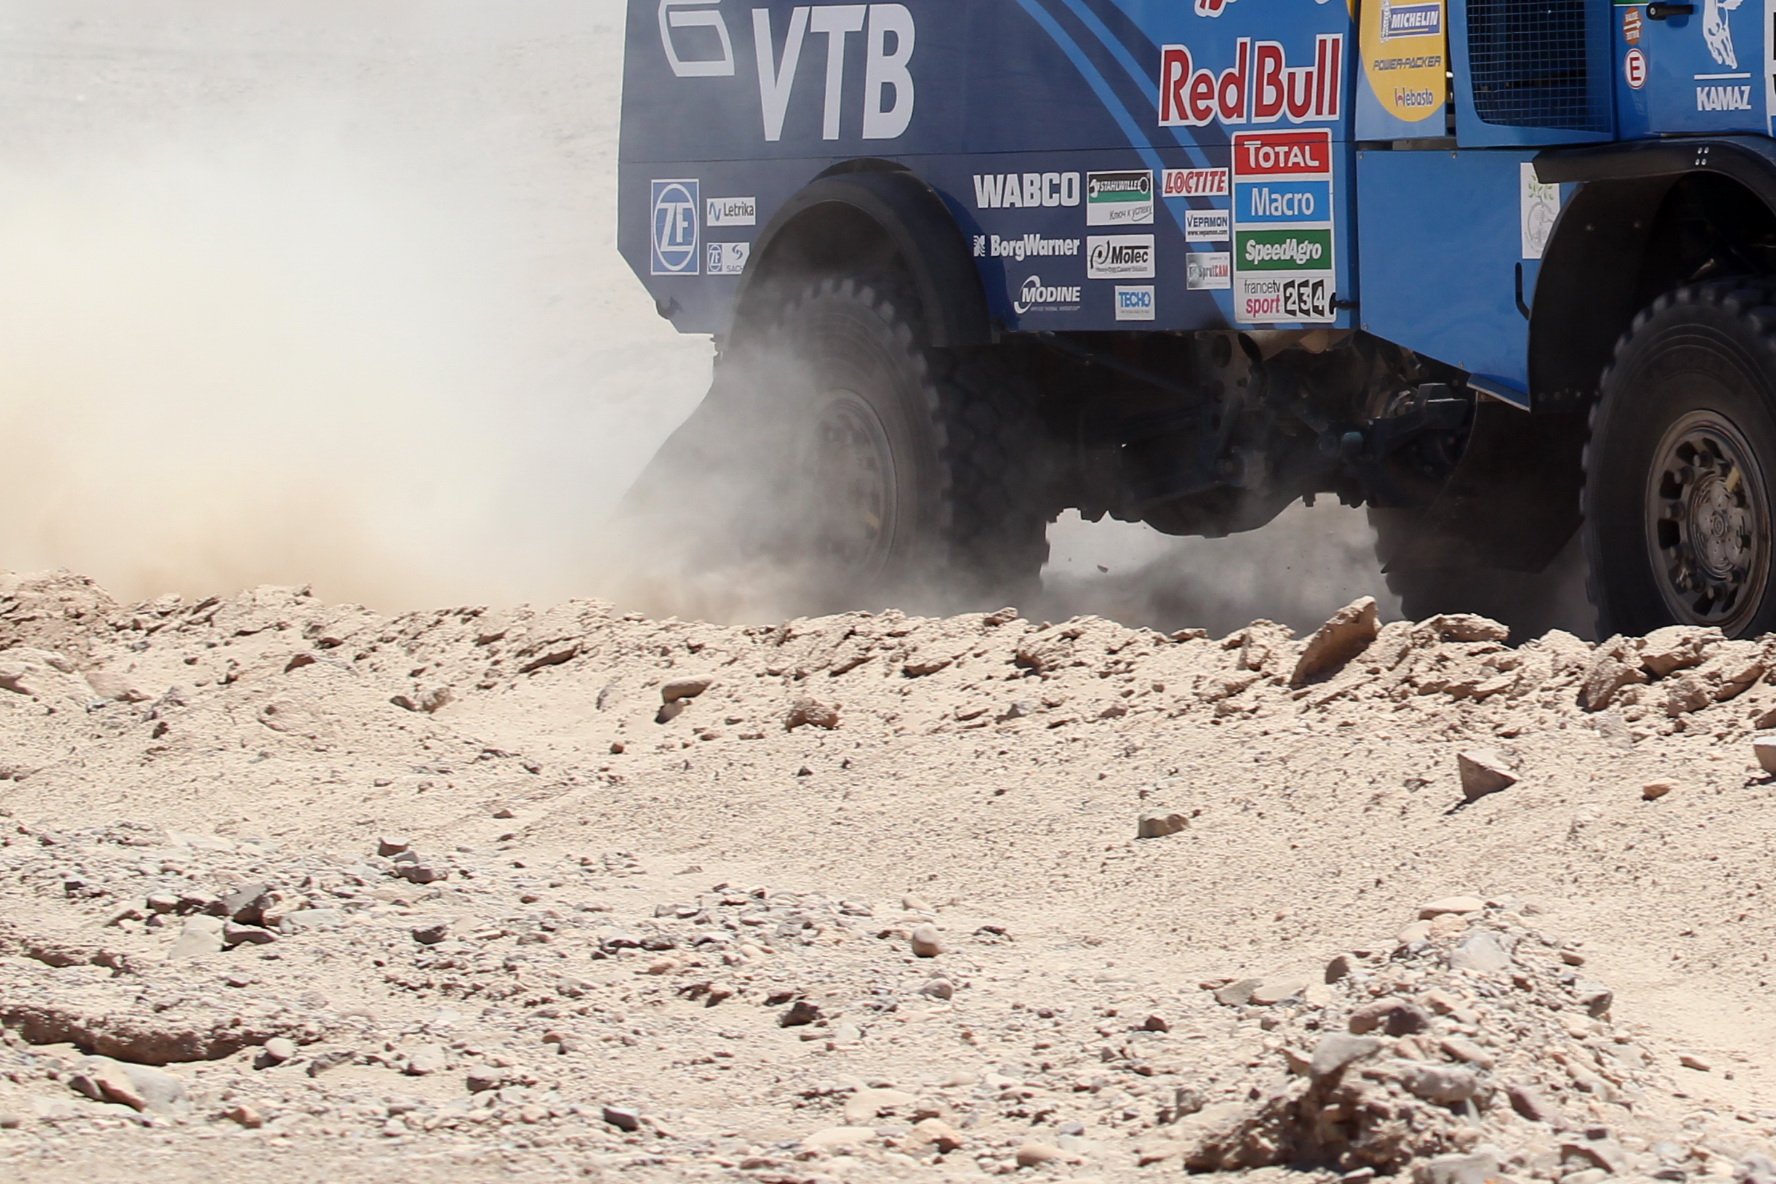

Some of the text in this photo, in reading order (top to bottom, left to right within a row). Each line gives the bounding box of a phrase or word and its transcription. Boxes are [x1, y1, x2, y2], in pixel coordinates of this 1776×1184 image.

[1391, 10, 1439, 29] MICHELIN
[752, 3, 916, 141] VTB
[1373, 55, 1442, 72] POWER-PACKER
[1630, 56, 1642, 82] E
[1160, 35, 1341, 124] Red Bull
[1395, 87, 1434, 107] Webasto
[1696, 85, 1752, 111] KAMAZ
[1244, 140, 1320, 169] TOTAL
[973, 171, 1081, 208] WABCO
[1164, 170, 1227, 194] LOCTITE
[723, 200, 755, 217] Letrika
[1251, 187, 1315, 216] Macro
[657, 202, 693, 252] ZF
[1186, 214, 1228, 228] VEPAMON
[990, 233, 1081, 262] BorgWarner
[1245, 238, 1322, 265] SpeedAgro
[1022, 286, 1081, 303] MODINE
[1244, 279, 1281, 294] francetv
[1118, 291, 1152, 308] TECHO
[1245, 294, 1281, 318] sport
